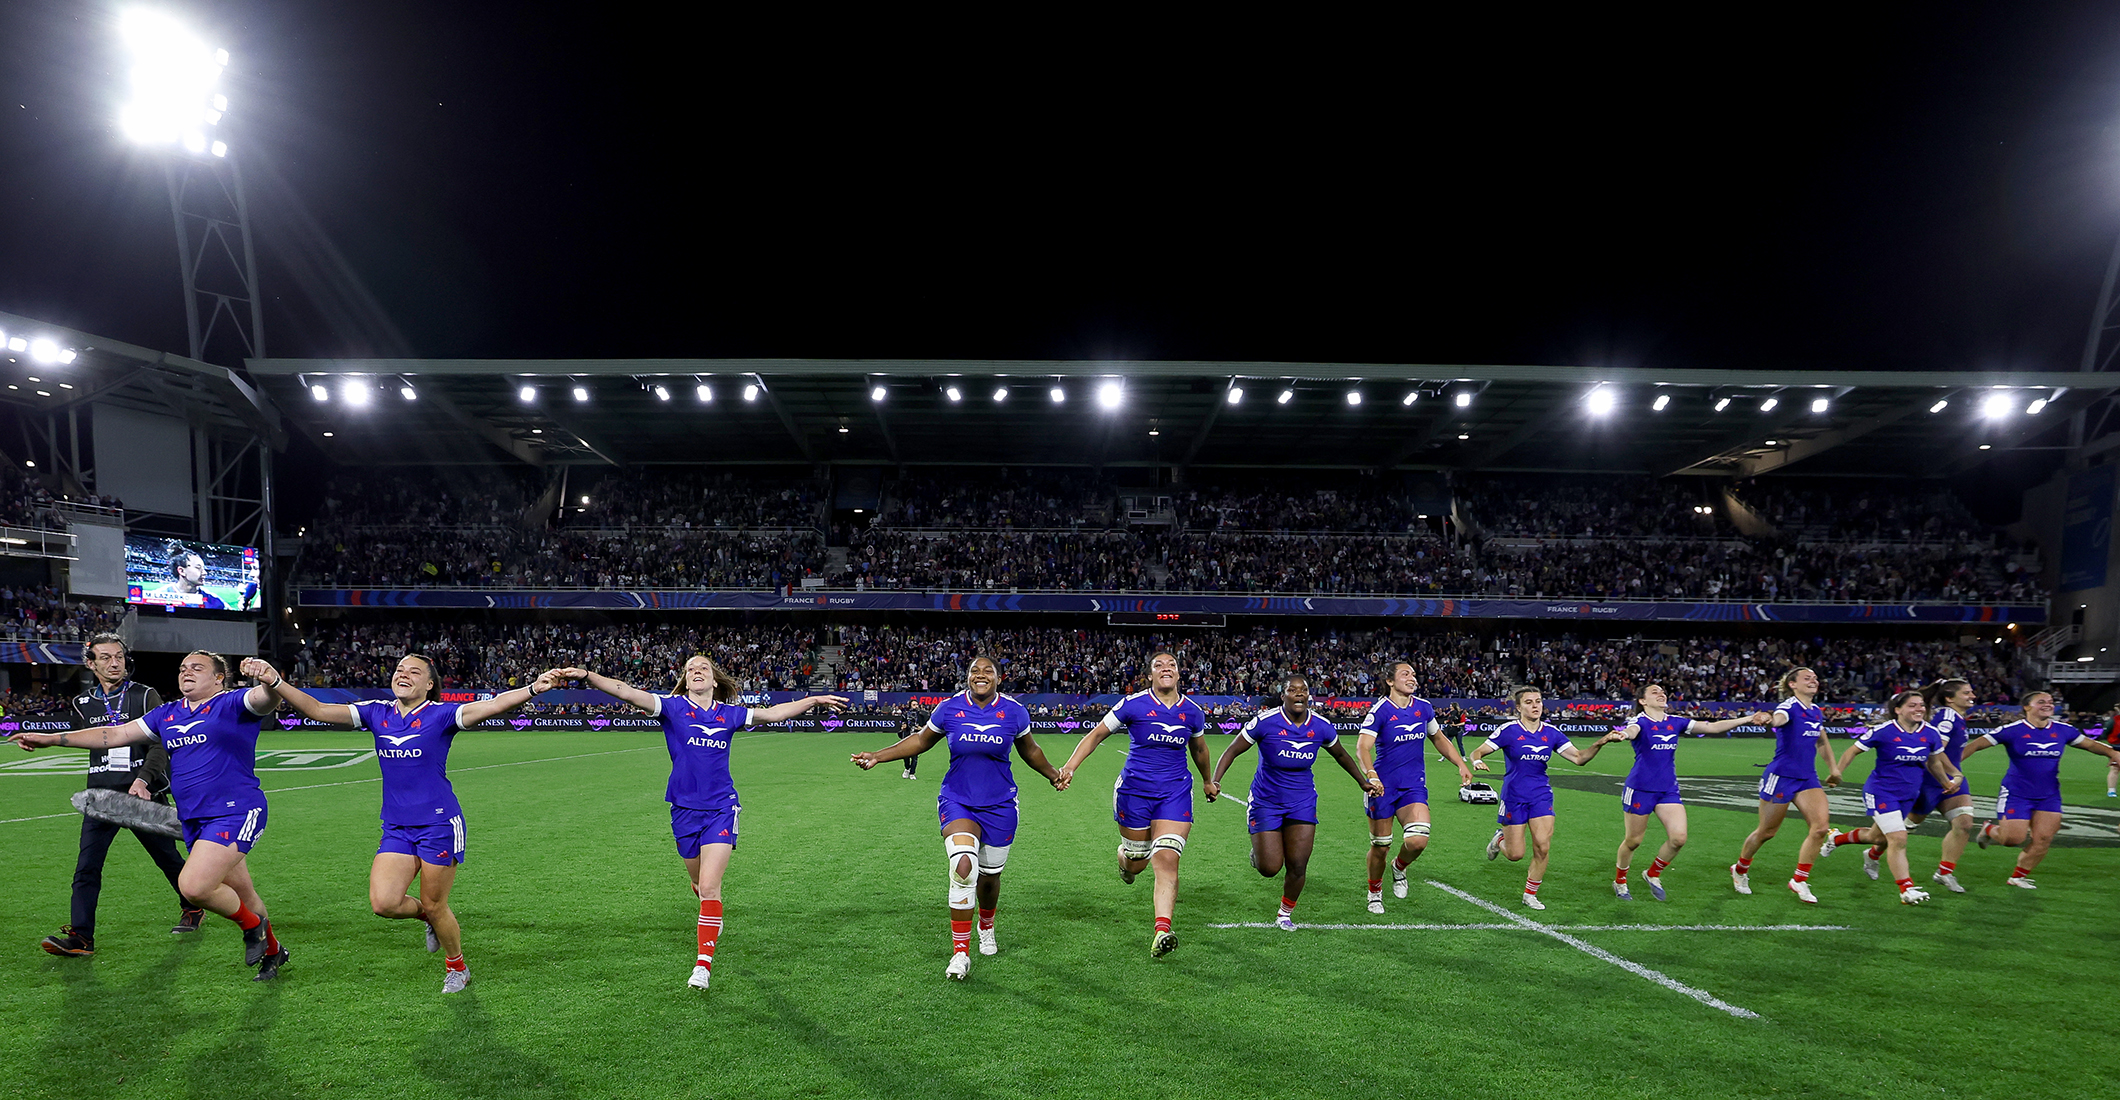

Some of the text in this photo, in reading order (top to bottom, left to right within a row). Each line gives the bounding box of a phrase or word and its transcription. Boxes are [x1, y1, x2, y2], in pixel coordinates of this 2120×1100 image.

[440, 693, 475, 702] FRANCE
[22, 720, 71, 730] GREATNESS
[535, 718, 582, 727] GREATNESS
[612, 718, 661, 727] GREATNESS
[846, 719, 896, 728] GREATNESS
[1559, 723, 1608, 732] GREATNESS
[166, 734, 207, 749] ALTRAD
[959, 733, 1003, 744] ALTRAD
[1147, 733, 1185, 744] ALTRAD
[1394, 732, 1425, 742] ALTRAD
[686, 736, 727, 749] ALTRAD
[378, 748, 422, 758] ALTRAD
[1278, 749, 1314, 759] ALTRAD
